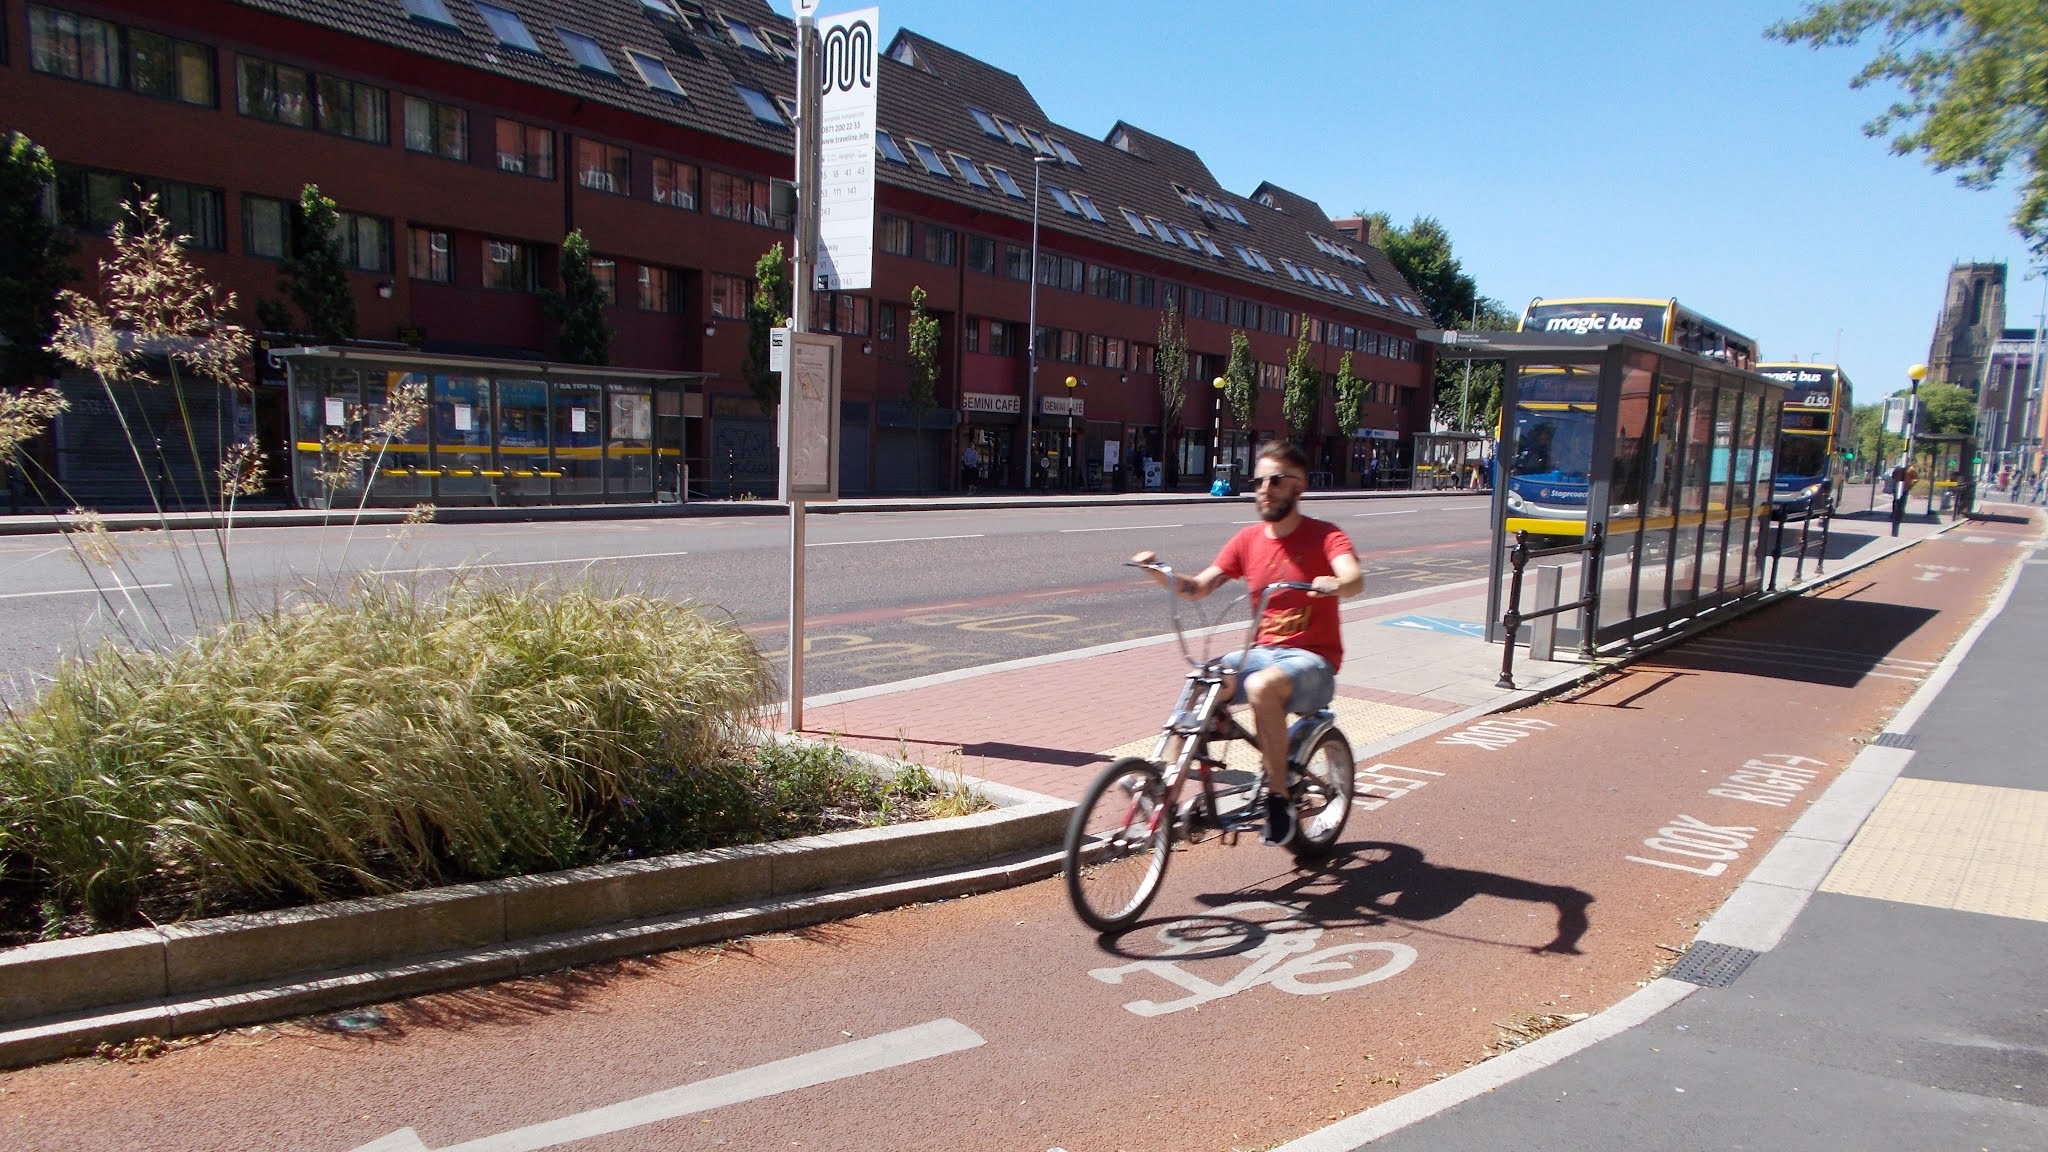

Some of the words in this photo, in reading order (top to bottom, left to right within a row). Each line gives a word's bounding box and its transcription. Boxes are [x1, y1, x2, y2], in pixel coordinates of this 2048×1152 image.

[1545, 313, 1606, 334] magic
[1608, 313, 1643, 330] bus
[1798, 371, 1822, 382] bus
[963, 395, 993, 410] GEMINI
[1044, 400, 1066, 412] GEMINI
[1435, 717, 1558, 751] LOOK
[1707, 753, 1829, 808] RIGHT
[1624, 814, 1759, 878] LOOK
